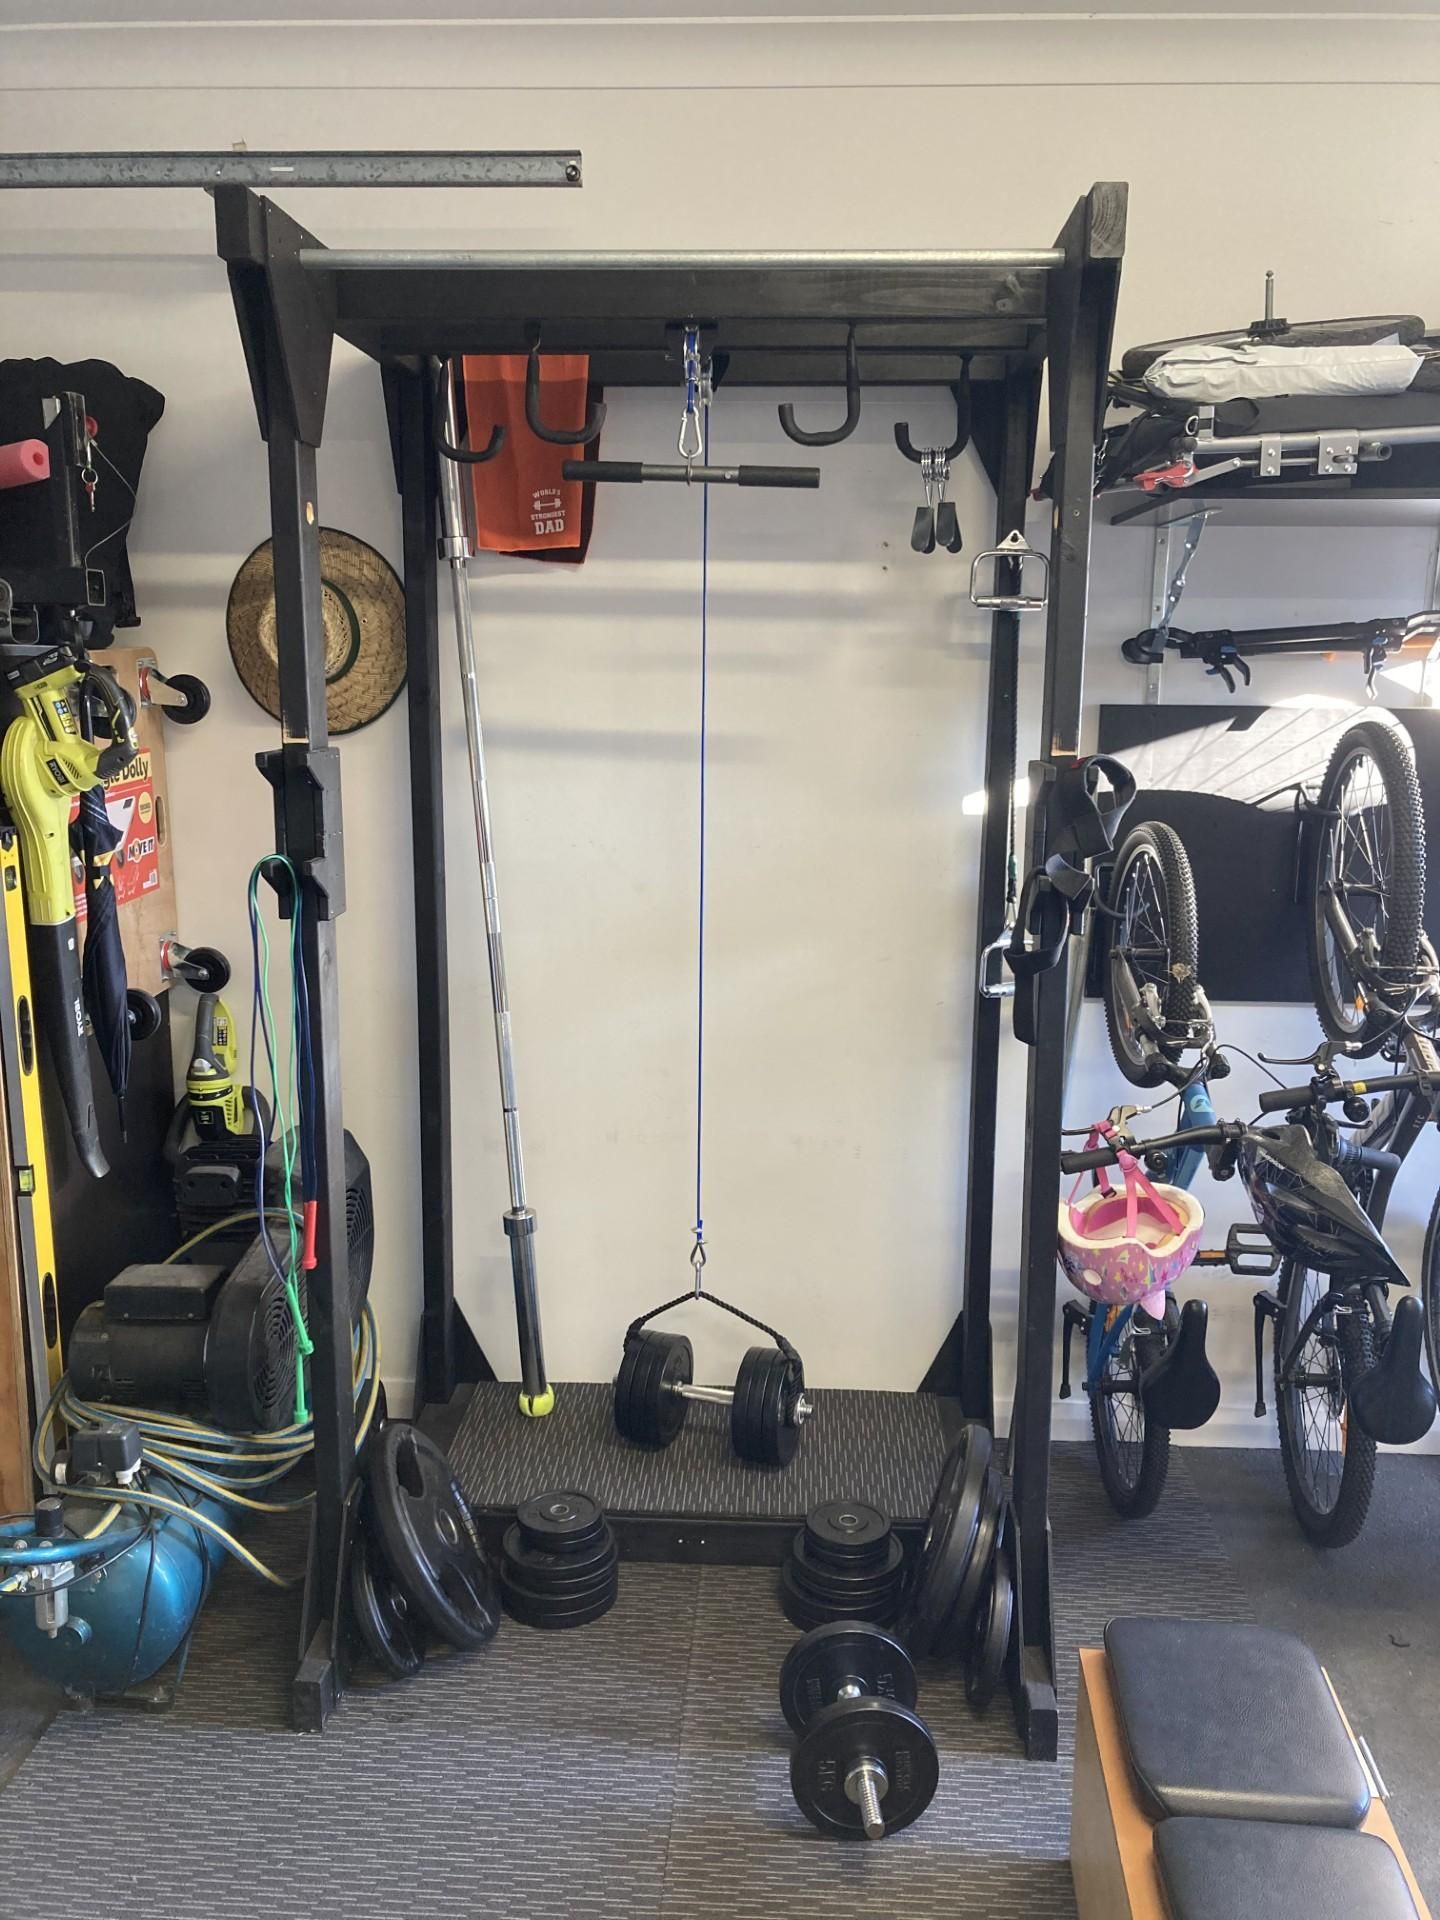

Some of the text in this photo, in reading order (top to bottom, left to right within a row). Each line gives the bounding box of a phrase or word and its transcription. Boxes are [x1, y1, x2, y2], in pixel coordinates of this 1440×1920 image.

[530, 510, 566, 520] STRONGEST
[534, 519, 565, 535] DAD
[122, 757, 149, 780] Dolly
